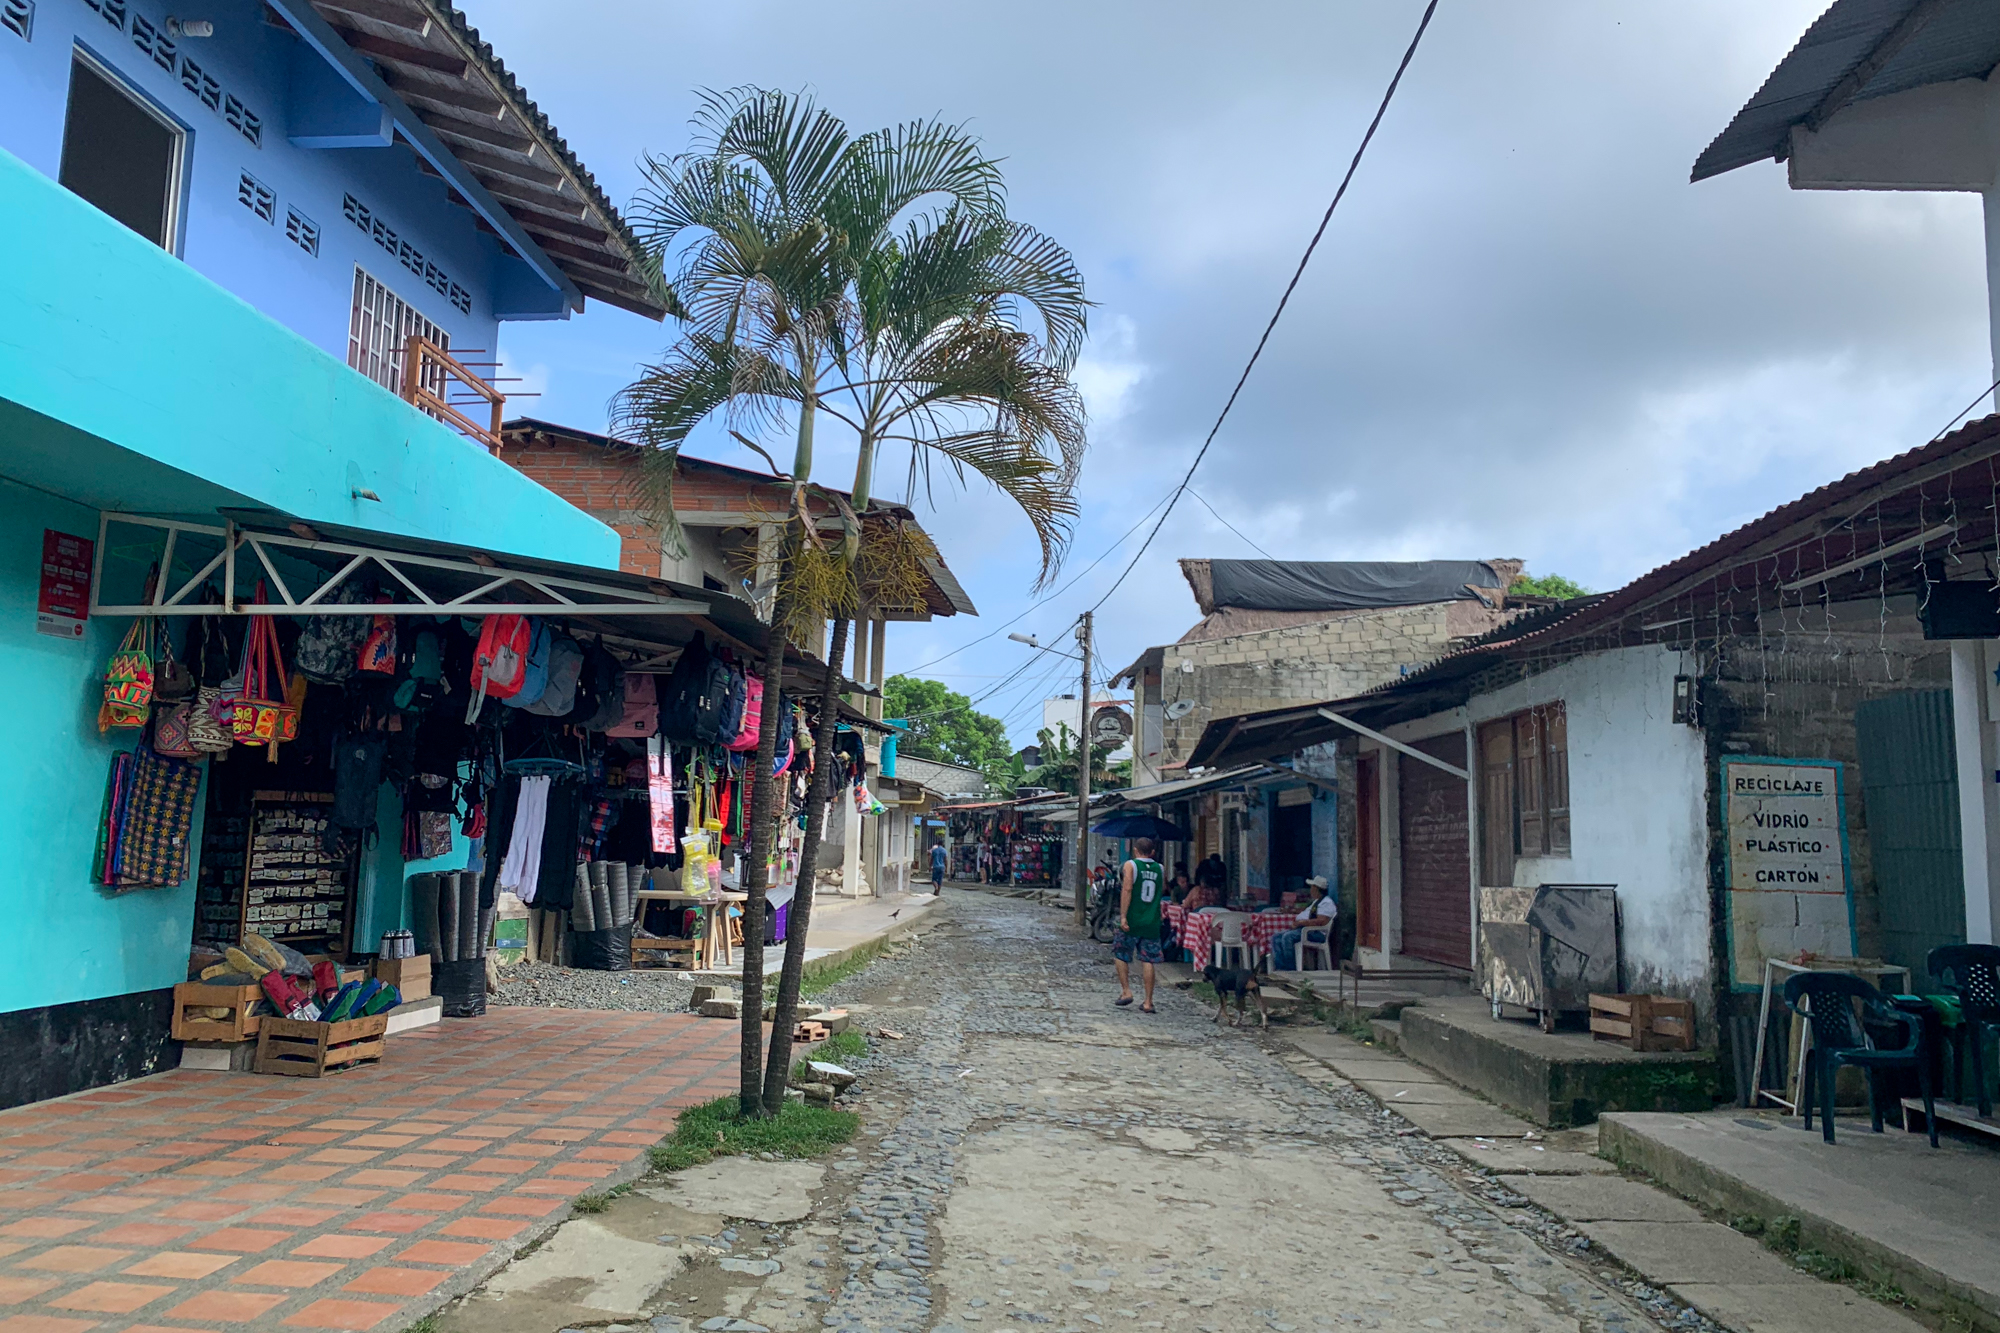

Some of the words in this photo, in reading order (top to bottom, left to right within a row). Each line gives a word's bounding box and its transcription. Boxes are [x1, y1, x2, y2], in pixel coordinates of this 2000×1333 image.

[1735, 774, 1823, 793] RECICLAJE
[1753, 809, 1809, 828] VIDRIO
[1746, 834, 1822, 853] PLÁSTICO
[1755, 863, 1819, 883] CARTÓN
[1140, 879, 1156, 903] 0
